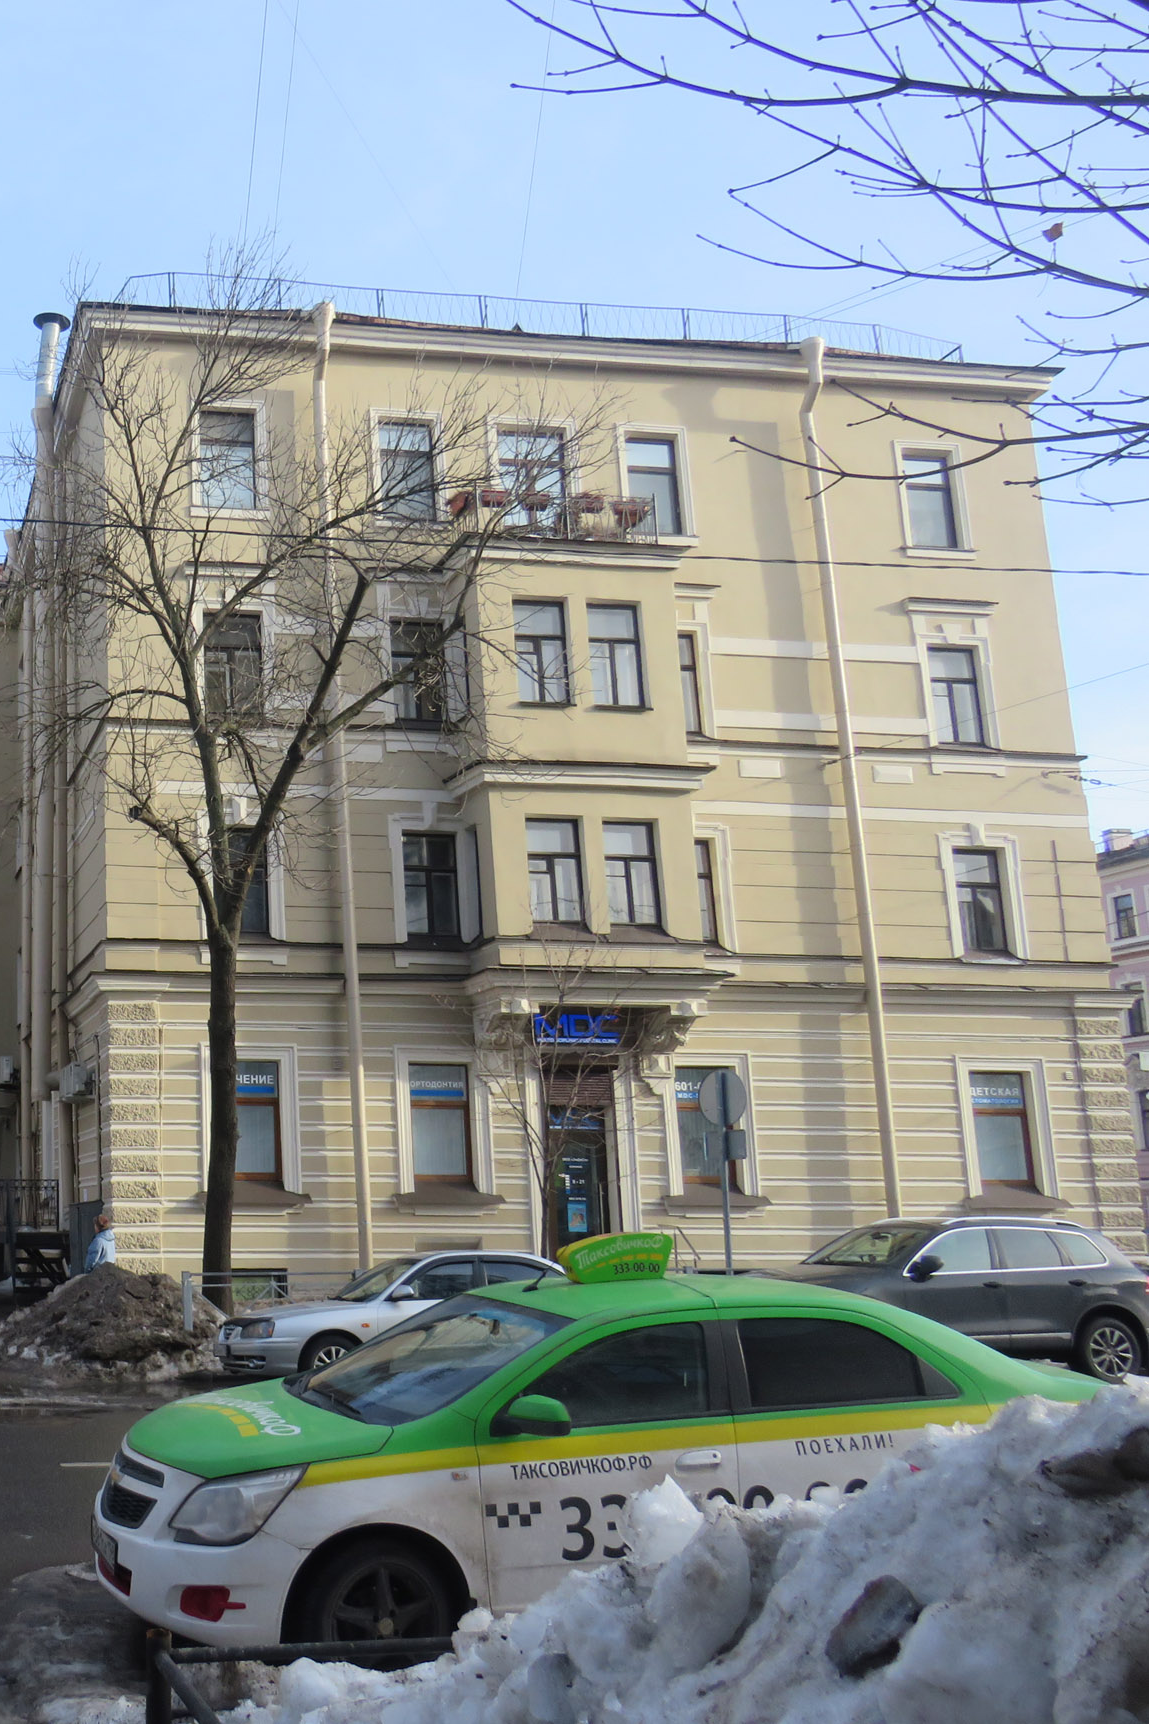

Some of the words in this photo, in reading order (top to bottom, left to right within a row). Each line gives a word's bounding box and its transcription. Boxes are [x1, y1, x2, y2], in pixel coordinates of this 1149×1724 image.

[534, 1014, 619, 1037] MDC
[235, 1074, 275, 1084] ЧЕНИЕ
[410, 1080, 464, 1089] ОРТОДОНТИЯ
[969, 1087, 1019, 1096] ДЕТСКАЯ
[794, 1433, 894, 1456] ПОЕХАЛИ!
[510, 1454, 652, 1480] ТАКСОВИЧКОФ.РФ
